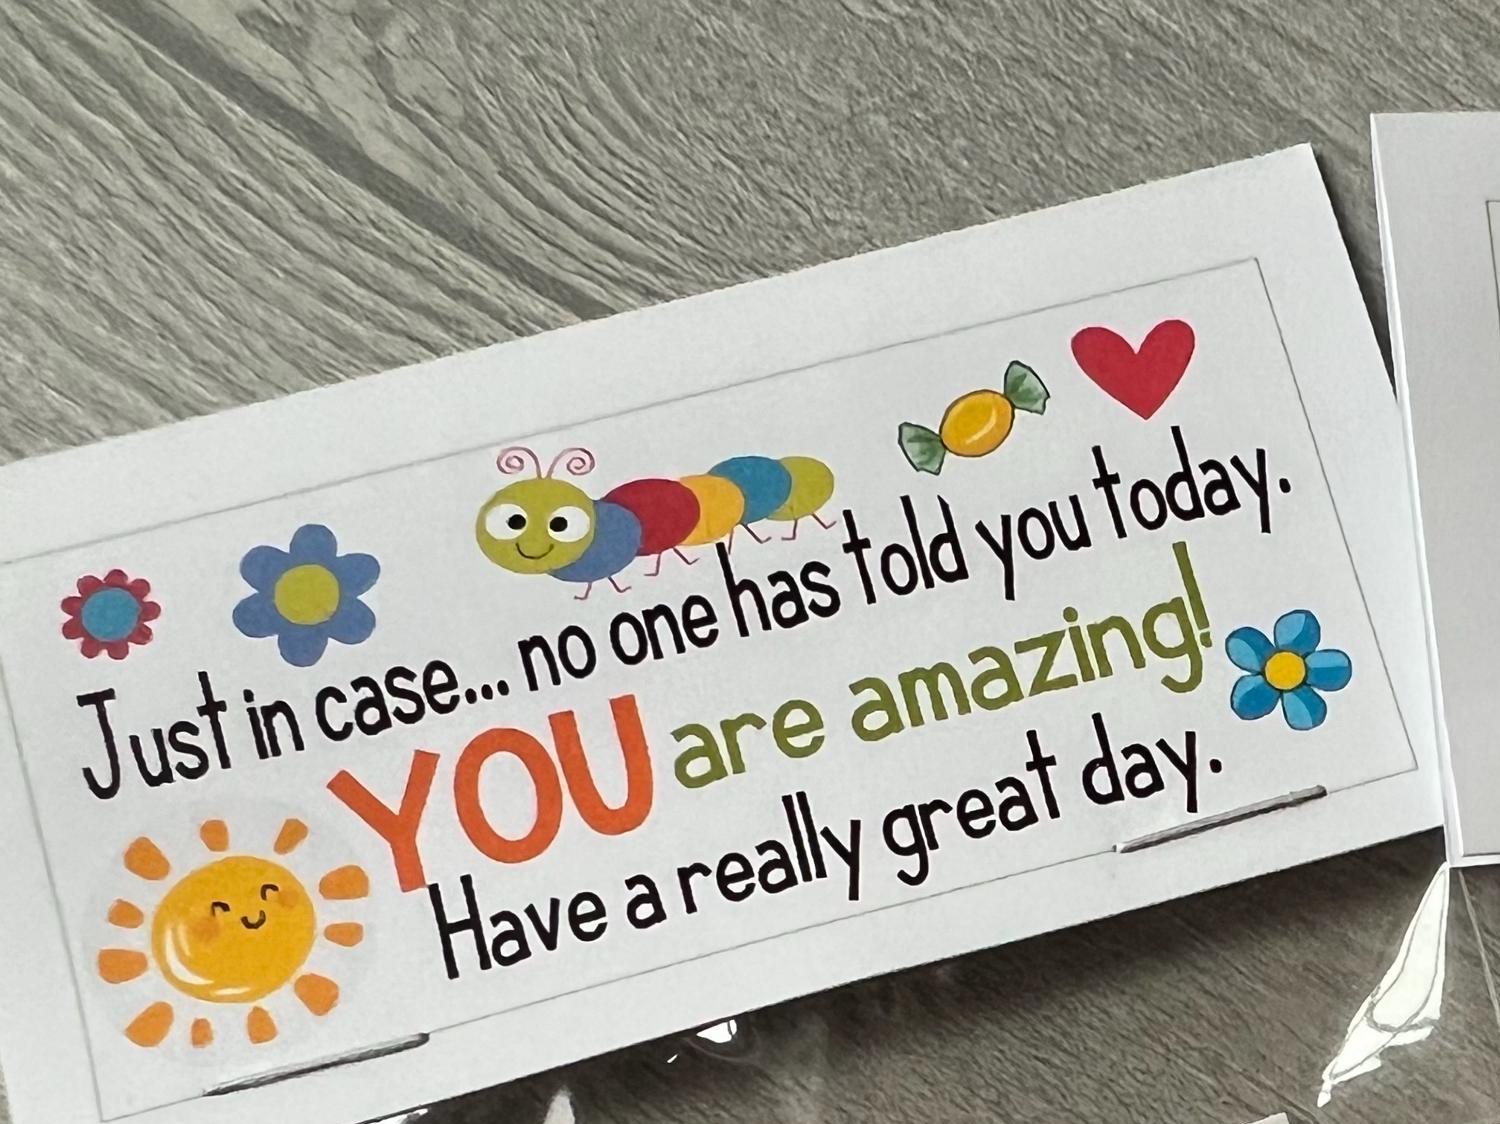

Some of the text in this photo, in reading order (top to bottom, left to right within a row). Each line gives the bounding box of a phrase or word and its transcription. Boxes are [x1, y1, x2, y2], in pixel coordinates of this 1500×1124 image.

[77, 426, 1290, 799] Just in case... no one has told you today.
[326, 542, 1211, 892] YOU are amazing!
[428, 713, 1221, 979] Have a really great day.
